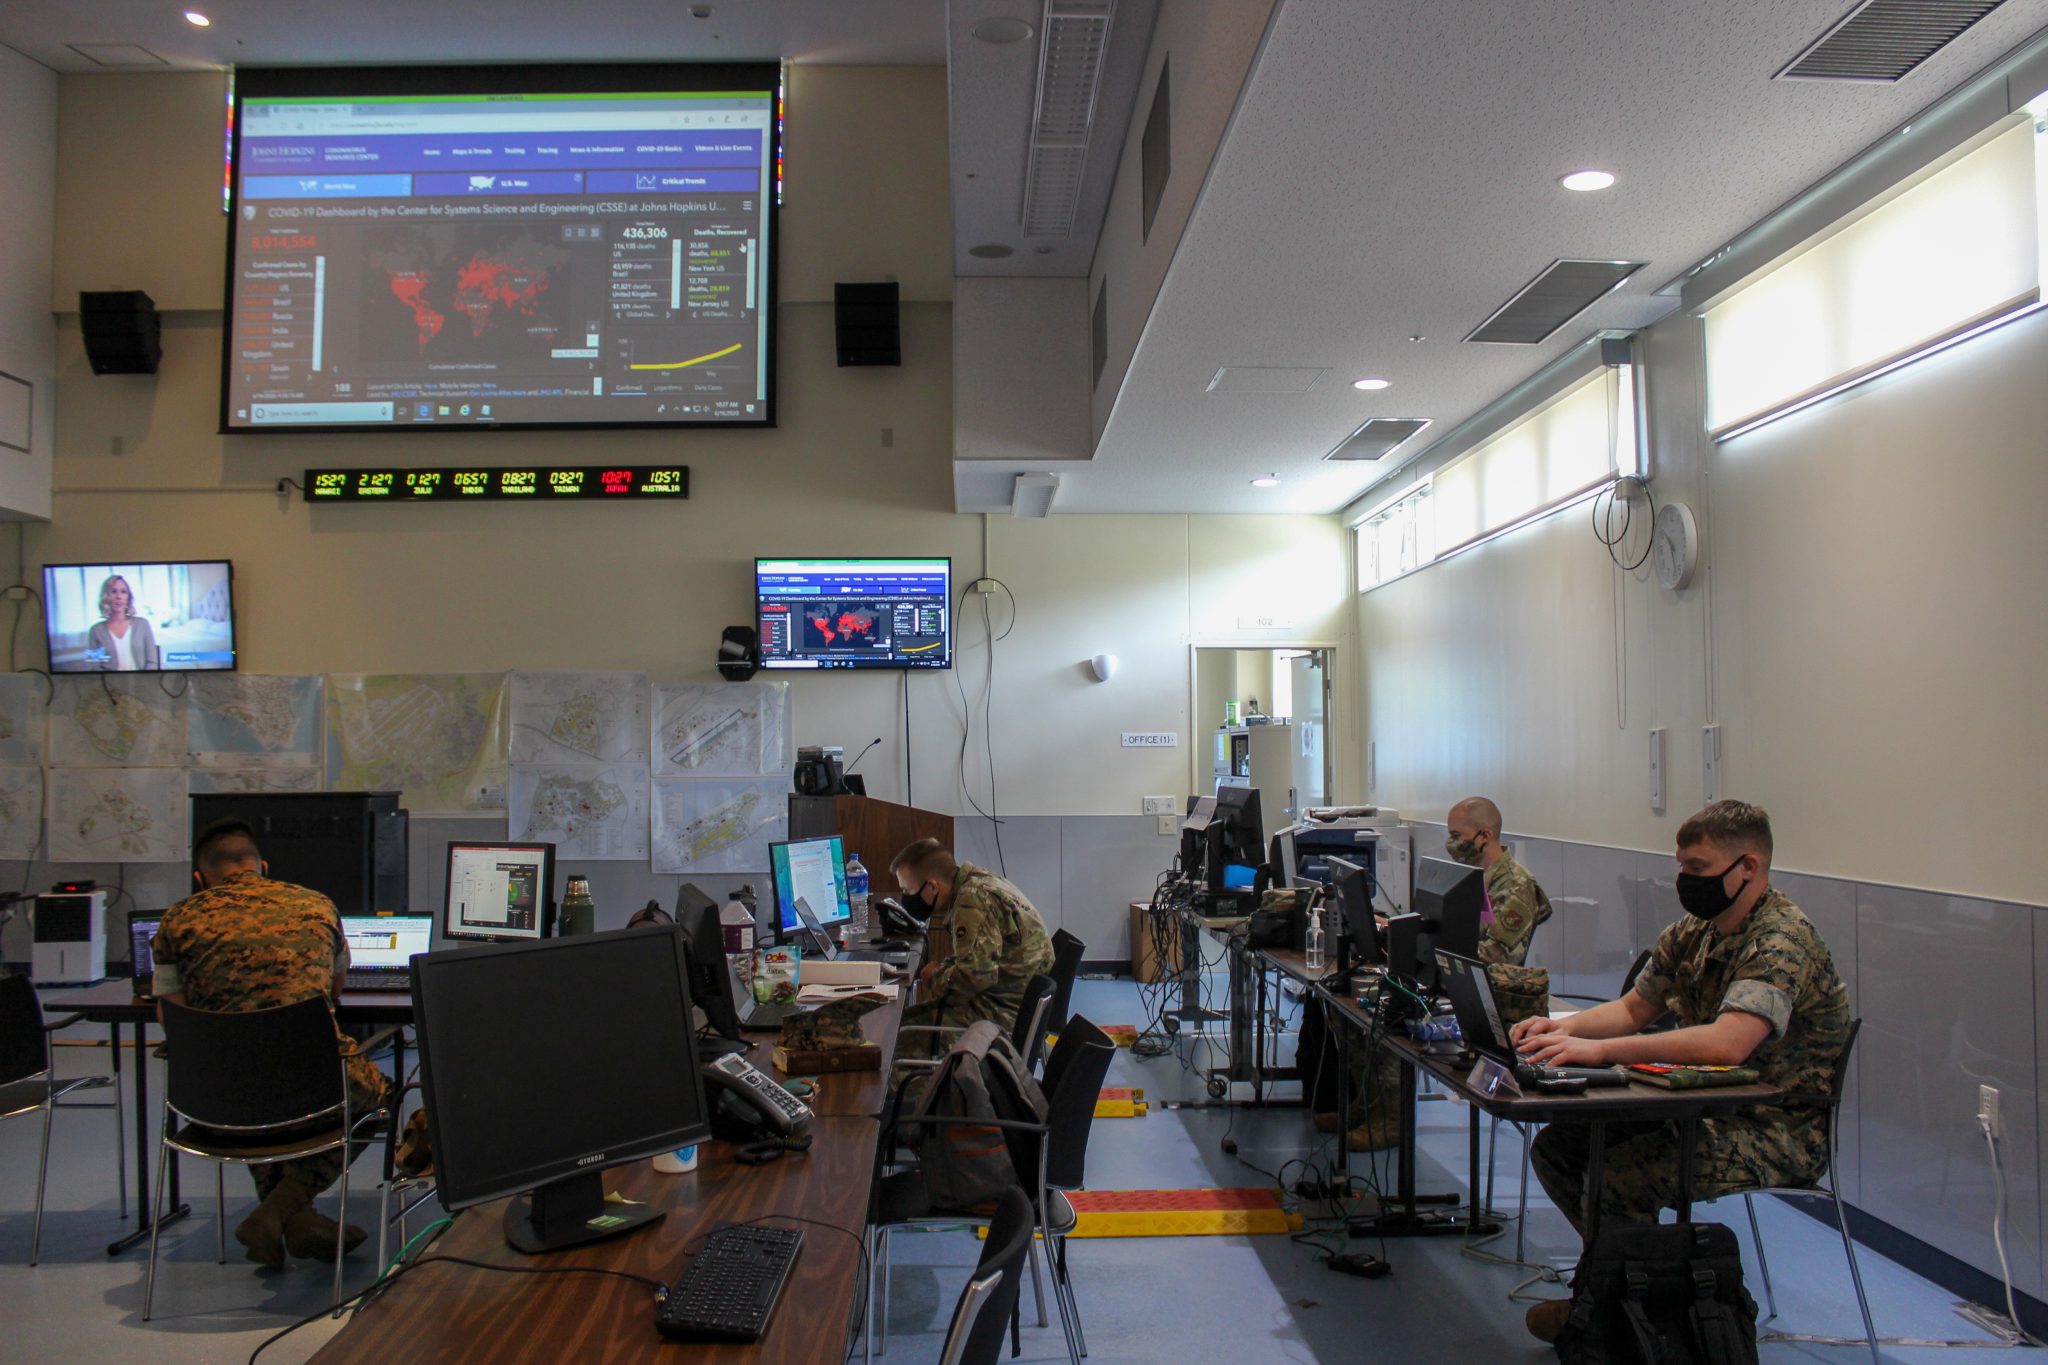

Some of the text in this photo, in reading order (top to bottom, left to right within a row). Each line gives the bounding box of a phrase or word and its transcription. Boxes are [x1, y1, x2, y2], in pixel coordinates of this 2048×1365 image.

[268, 207, 314, 218] COVID-19
[316, 206, 366, 217] Dashboard
[368, 206, 378, 219] by
[381, 206, 395, 216] the
[397, 205, 427, 215] Center
[430, 205, 442, 215] for
[444, 205, 481, 216] Systems
[483, 204, 517, 214] Science
[522, 203, 537, 212] and
[539, 202, 594, 215] Engineering
[596, 202, 627, 213] (CSSE)
[629, 203, 638, 212] at
[640, 202, 667, 212] Johns
[669, 202, 707, 214] Hopkins
[623, 227, 667, 239] 436,306
[554, 485, 579, 493] TAIWAN
[1258, 618, 1272, 626] 102
[1128, 736, 1170, 744] OFFICE (1)
[765, 952, 787, 961] Dole
[577, 1153, 604, 1166] HYUNDAI
